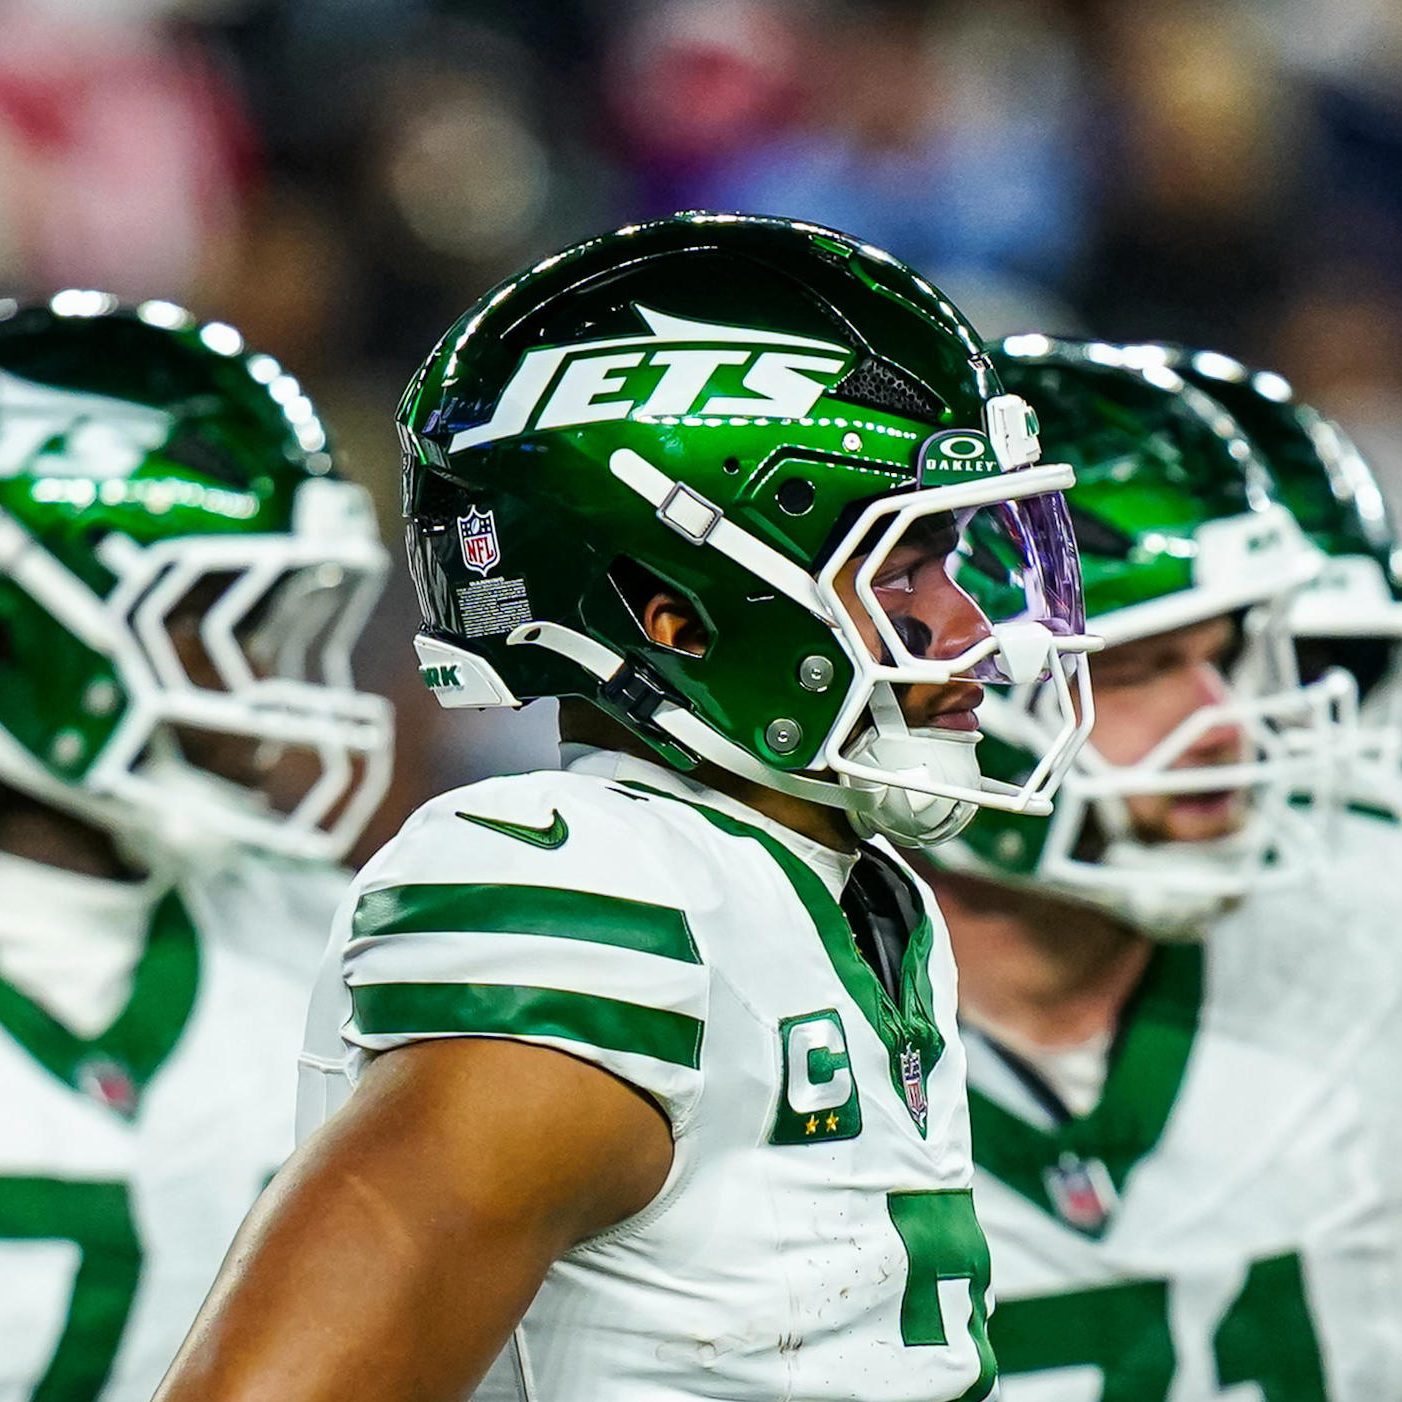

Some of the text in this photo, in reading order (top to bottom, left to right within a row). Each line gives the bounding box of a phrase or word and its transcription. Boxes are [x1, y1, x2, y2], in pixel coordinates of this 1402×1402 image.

[448, 303, 854, 453] JETS
[926, 459, 996, 472] OAKLEY
[463, 537, 494, 565] NFL
[787, 1018, 853, 1114] C
